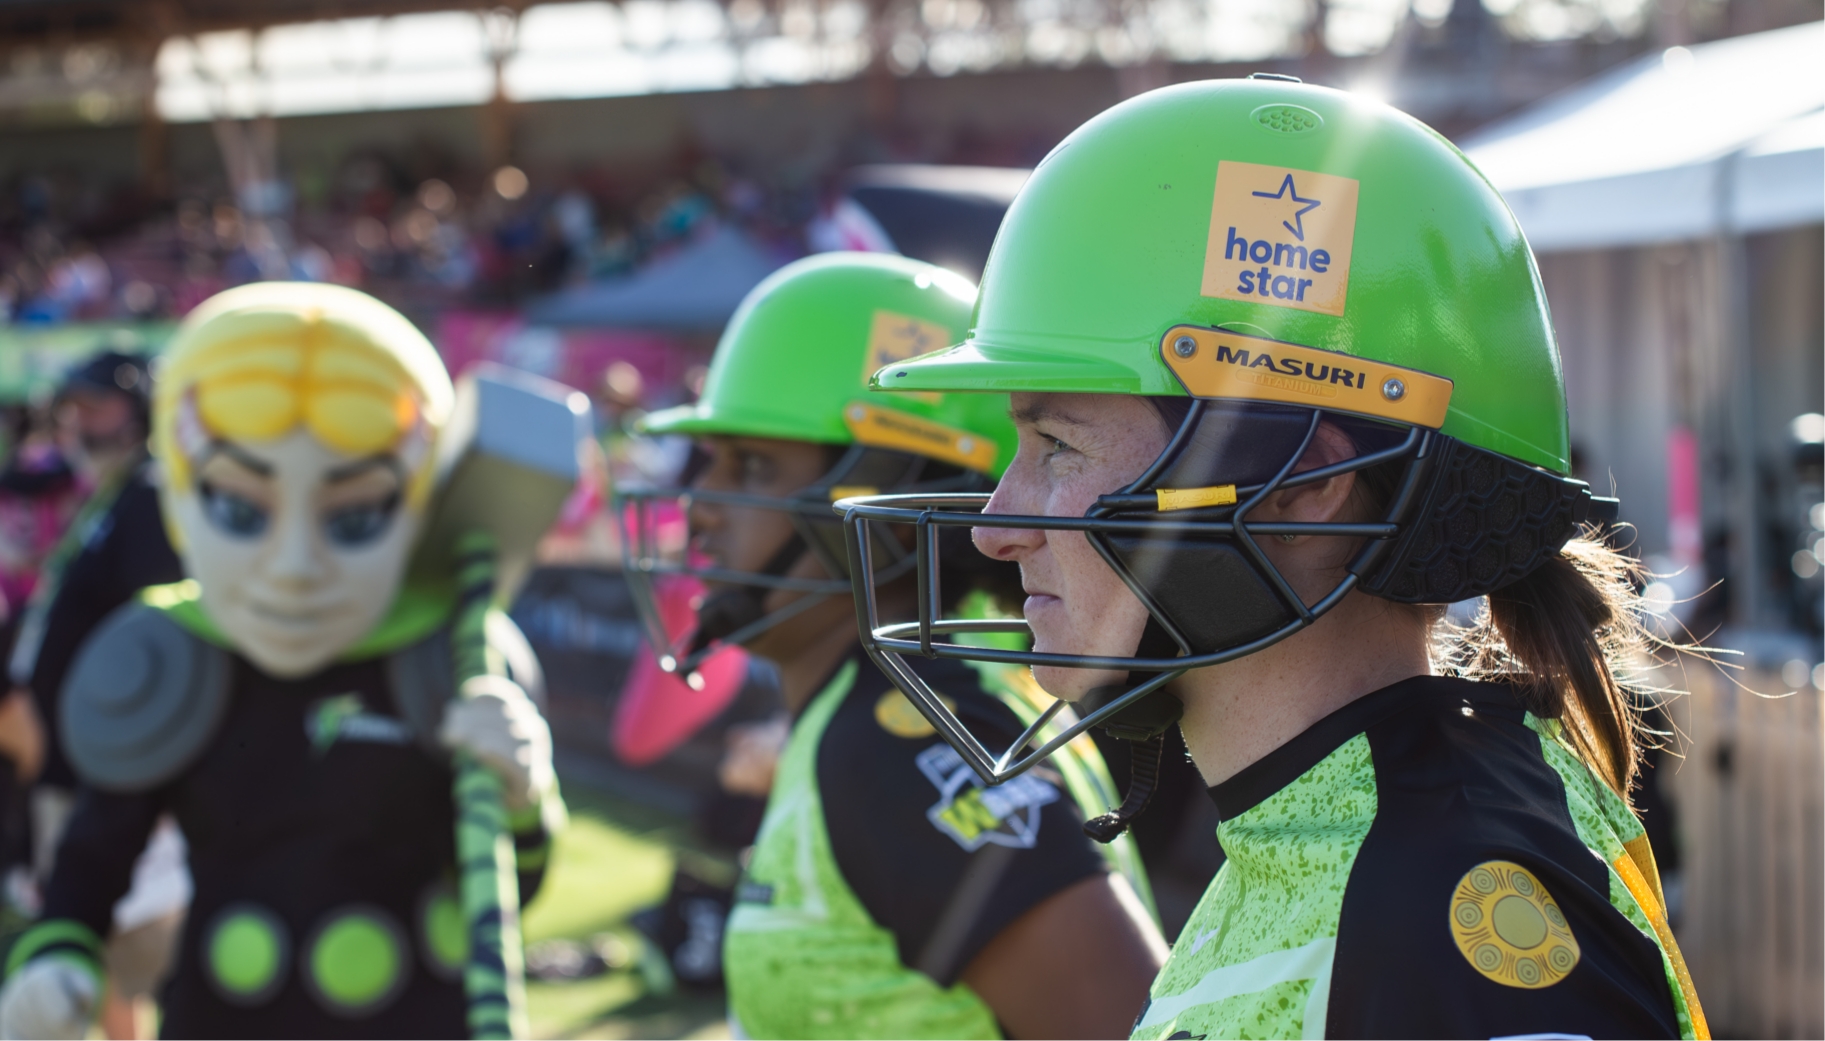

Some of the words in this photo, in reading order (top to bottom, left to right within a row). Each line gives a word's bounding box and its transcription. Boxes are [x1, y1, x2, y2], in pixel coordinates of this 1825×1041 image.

[1225, 226, 1331, 273] home
[1237, 267, 1312, 302] star
[1216, 345, 1366, 389] MASURI
[1252, 372, 1322, 396] TITANIUM
[1165, 491, 1232, 505] MASURI
